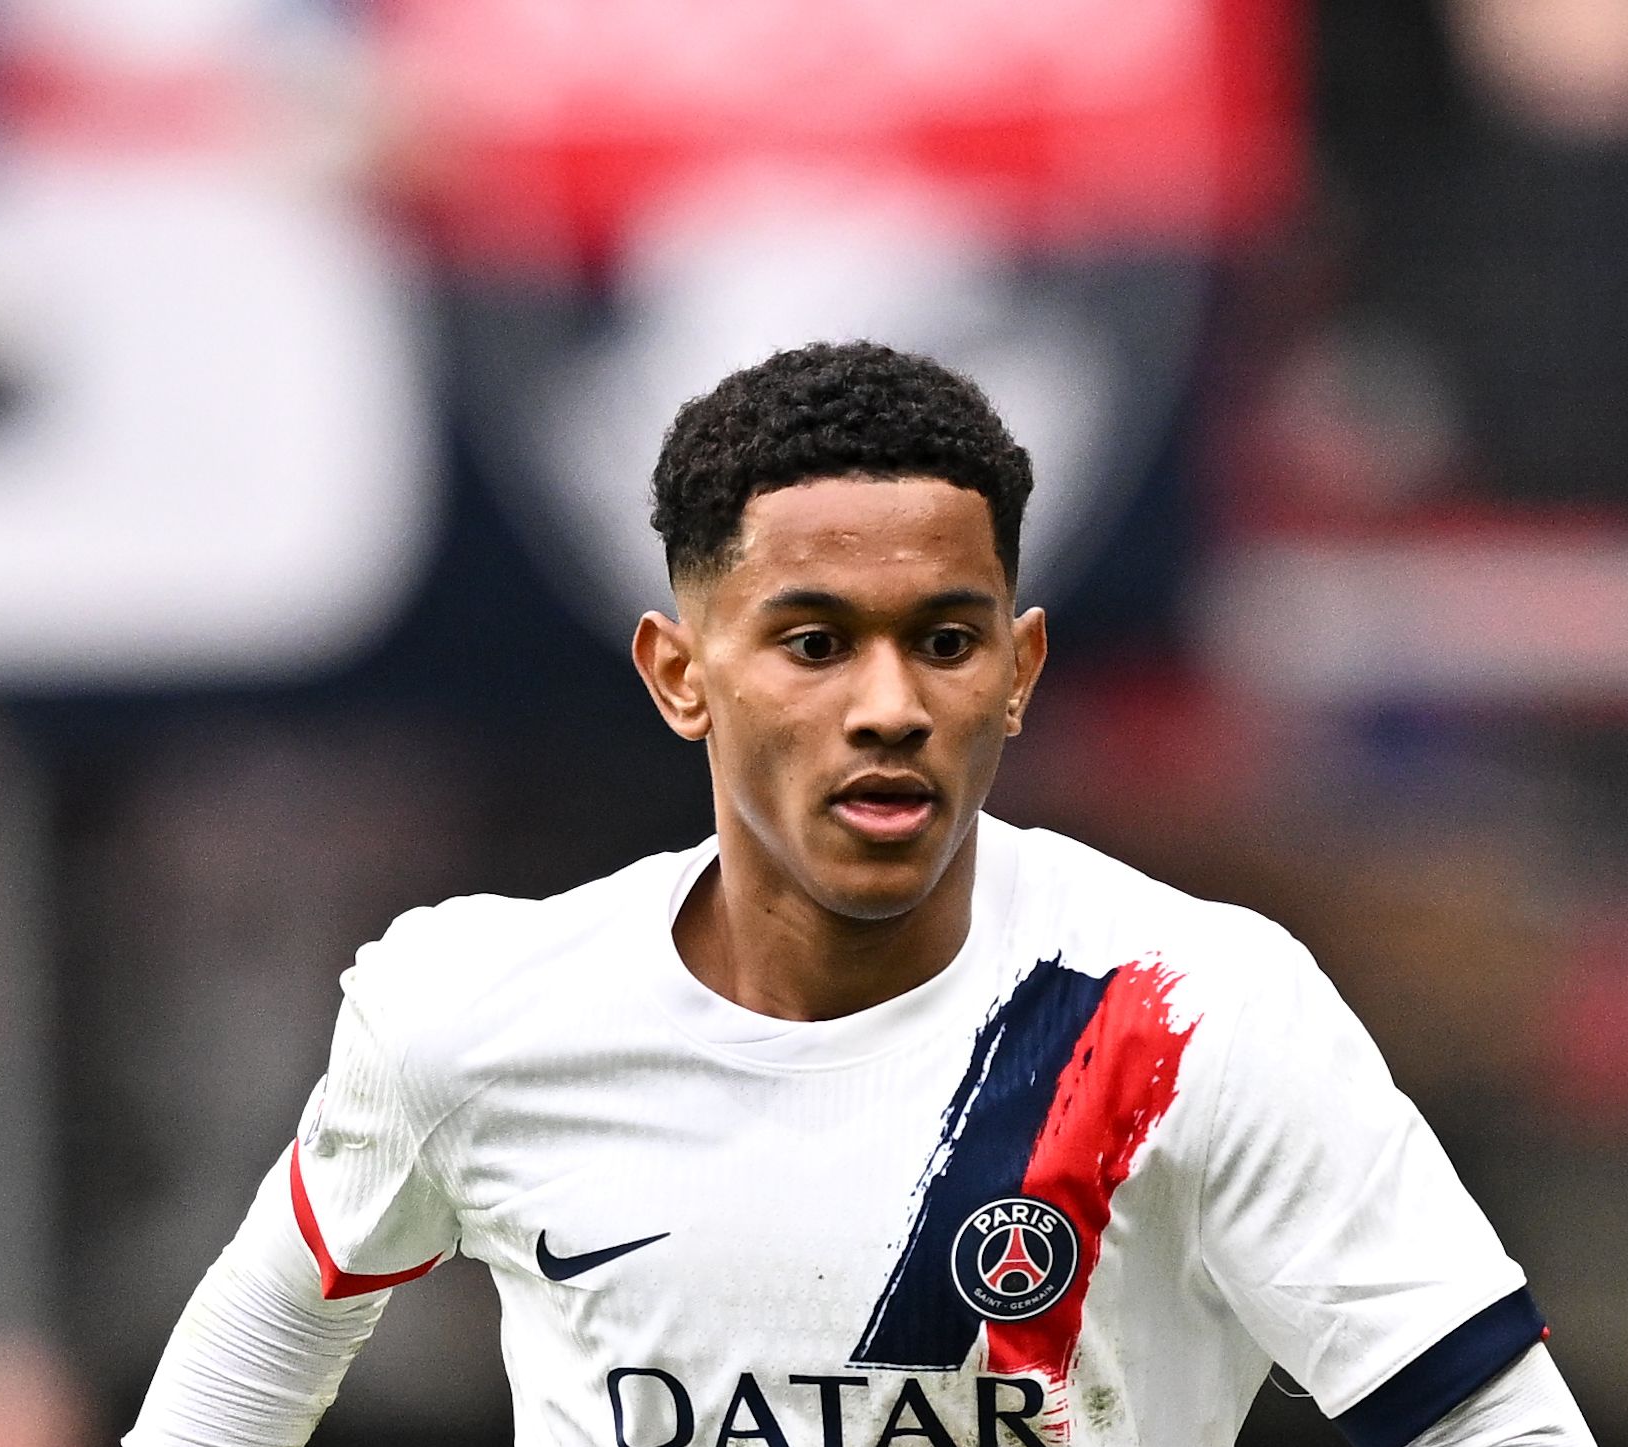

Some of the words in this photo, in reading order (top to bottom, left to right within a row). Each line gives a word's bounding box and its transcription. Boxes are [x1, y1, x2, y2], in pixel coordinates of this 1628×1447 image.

[973, 1204, 1057, 1235] PARIS
[973, 1287, 1002, 1308] SAINT
[1010, 1284, 1054, 1310] GERMAIN
